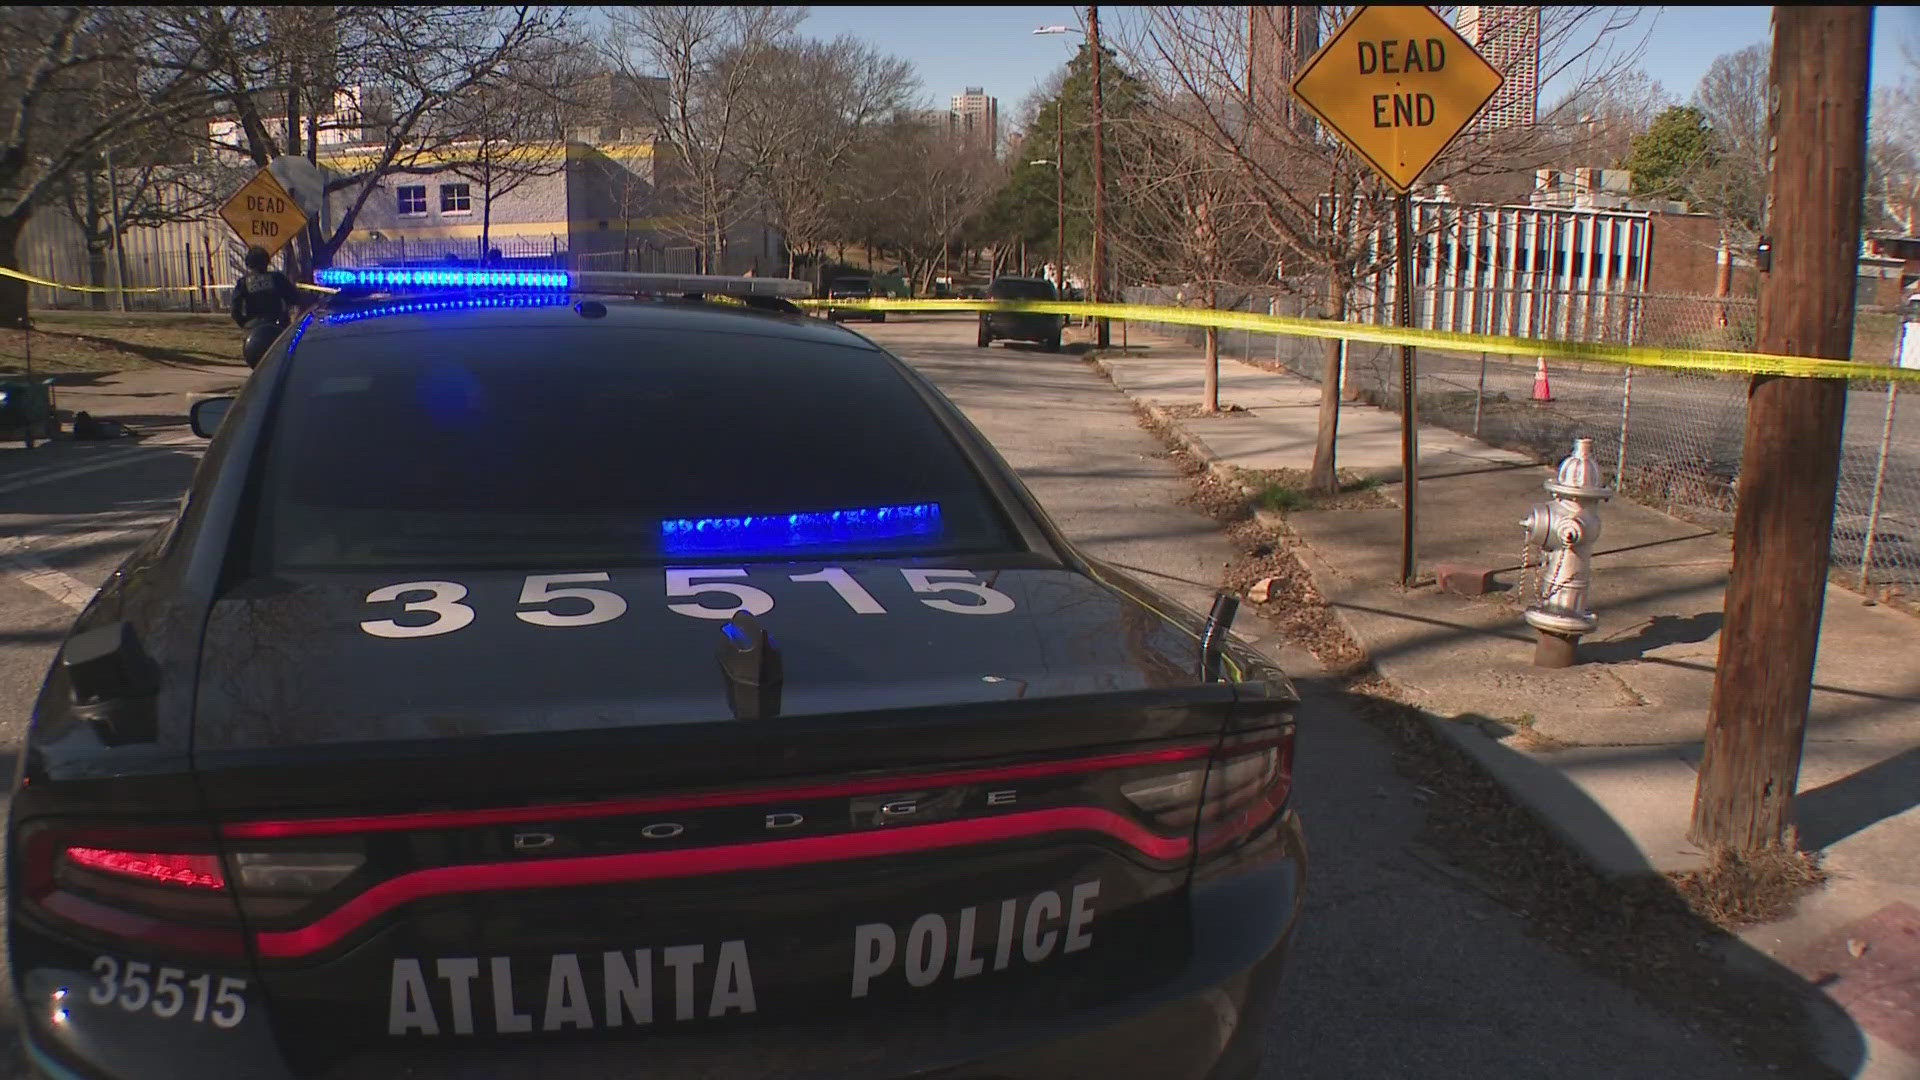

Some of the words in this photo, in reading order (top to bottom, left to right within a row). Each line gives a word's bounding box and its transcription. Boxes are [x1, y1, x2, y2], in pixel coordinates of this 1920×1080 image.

[1358, 39, 1445, 75] DEAD
[1373, 93, 1435, 128] END
[247, 196, 285, 213] DEAD
[251, 220, 279, 237] END
[360, 567, 1015, 638] 35515
[514, 790, 1017, 850] DODGE
[388, 940, 757, 1036] ATLANTA
[851, 880, 1101, 999] POLICE
[88, 955, 247, 1029] 35515
